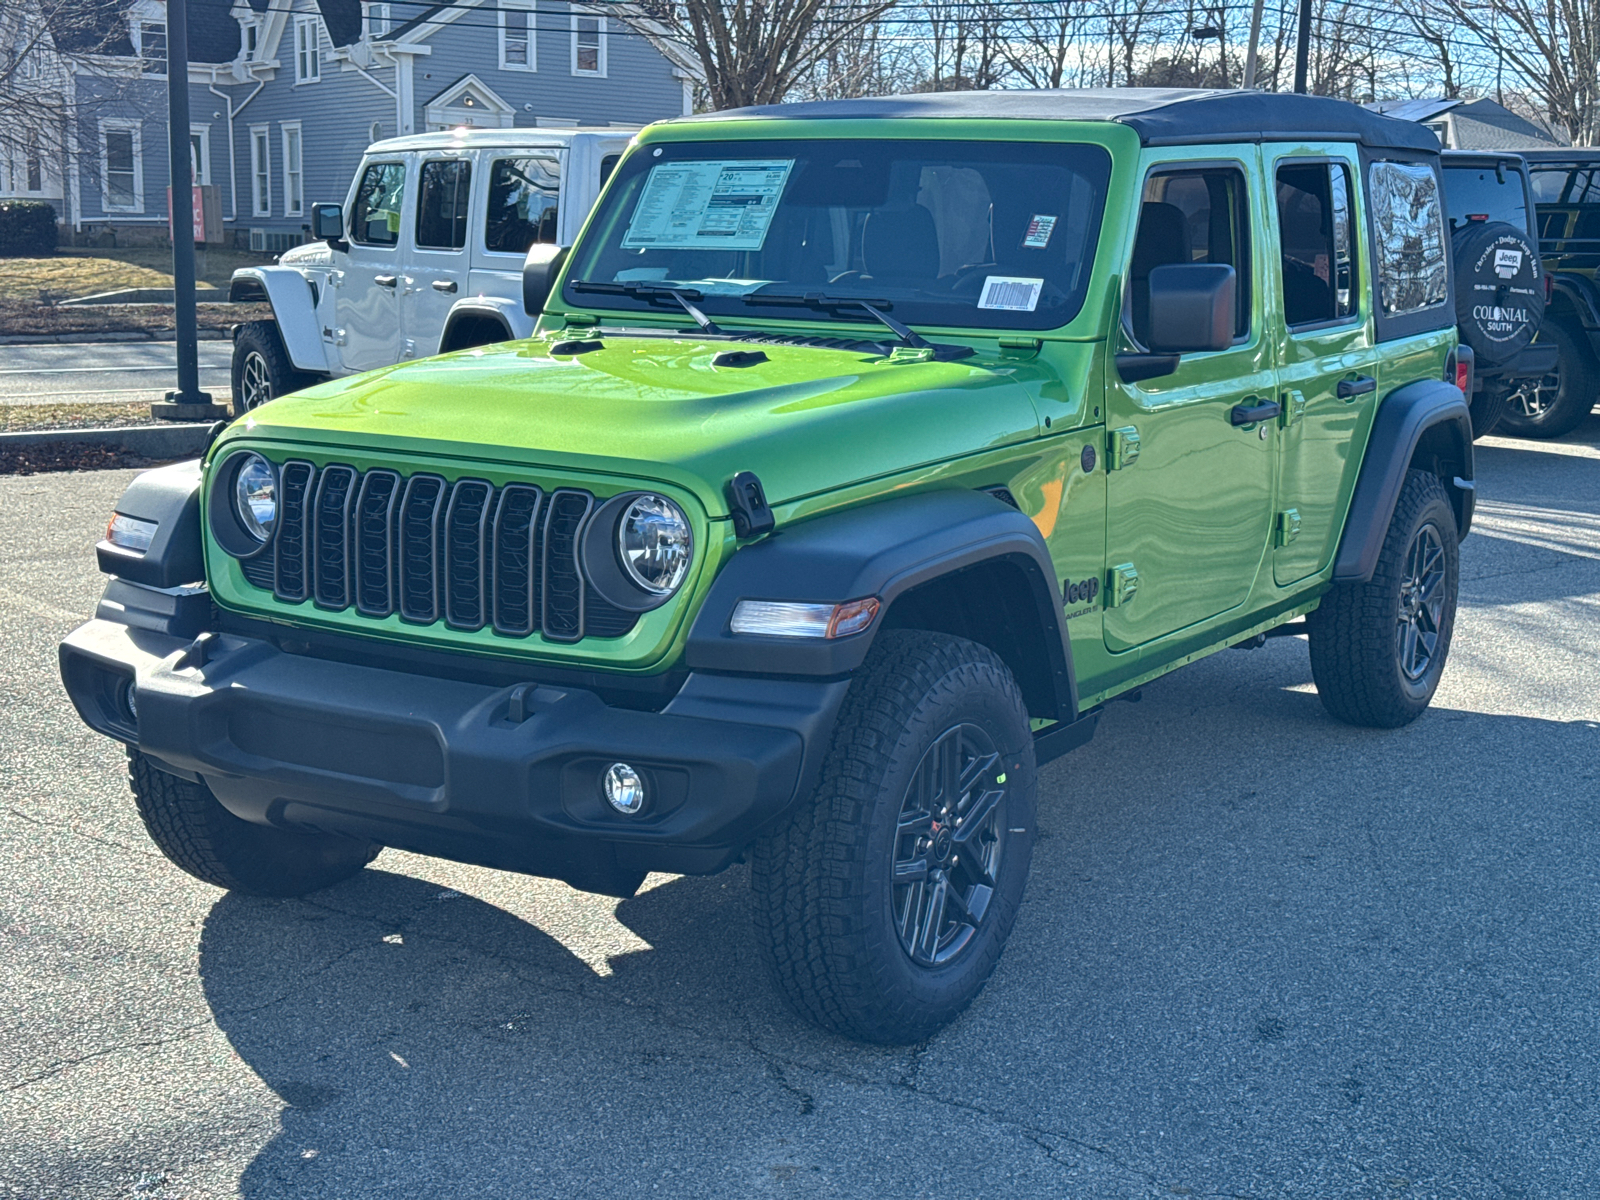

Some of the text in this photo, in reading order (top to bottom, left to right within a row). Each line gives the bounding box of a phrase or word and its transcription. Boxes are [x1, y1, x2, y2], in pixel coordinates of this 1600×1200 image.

[1474, 235, 1538, 279] Chrysler Dodge Jeep Ram
[1499, 252, 1518, 264] Jeep
[1472, 305, 1530, 323] COLONIAL
[1487, 321, 1513, 332] SOUTH
[1062, 576, 1099, 607] Jeep
[1065, 607, 1092, 620] ANGLER
